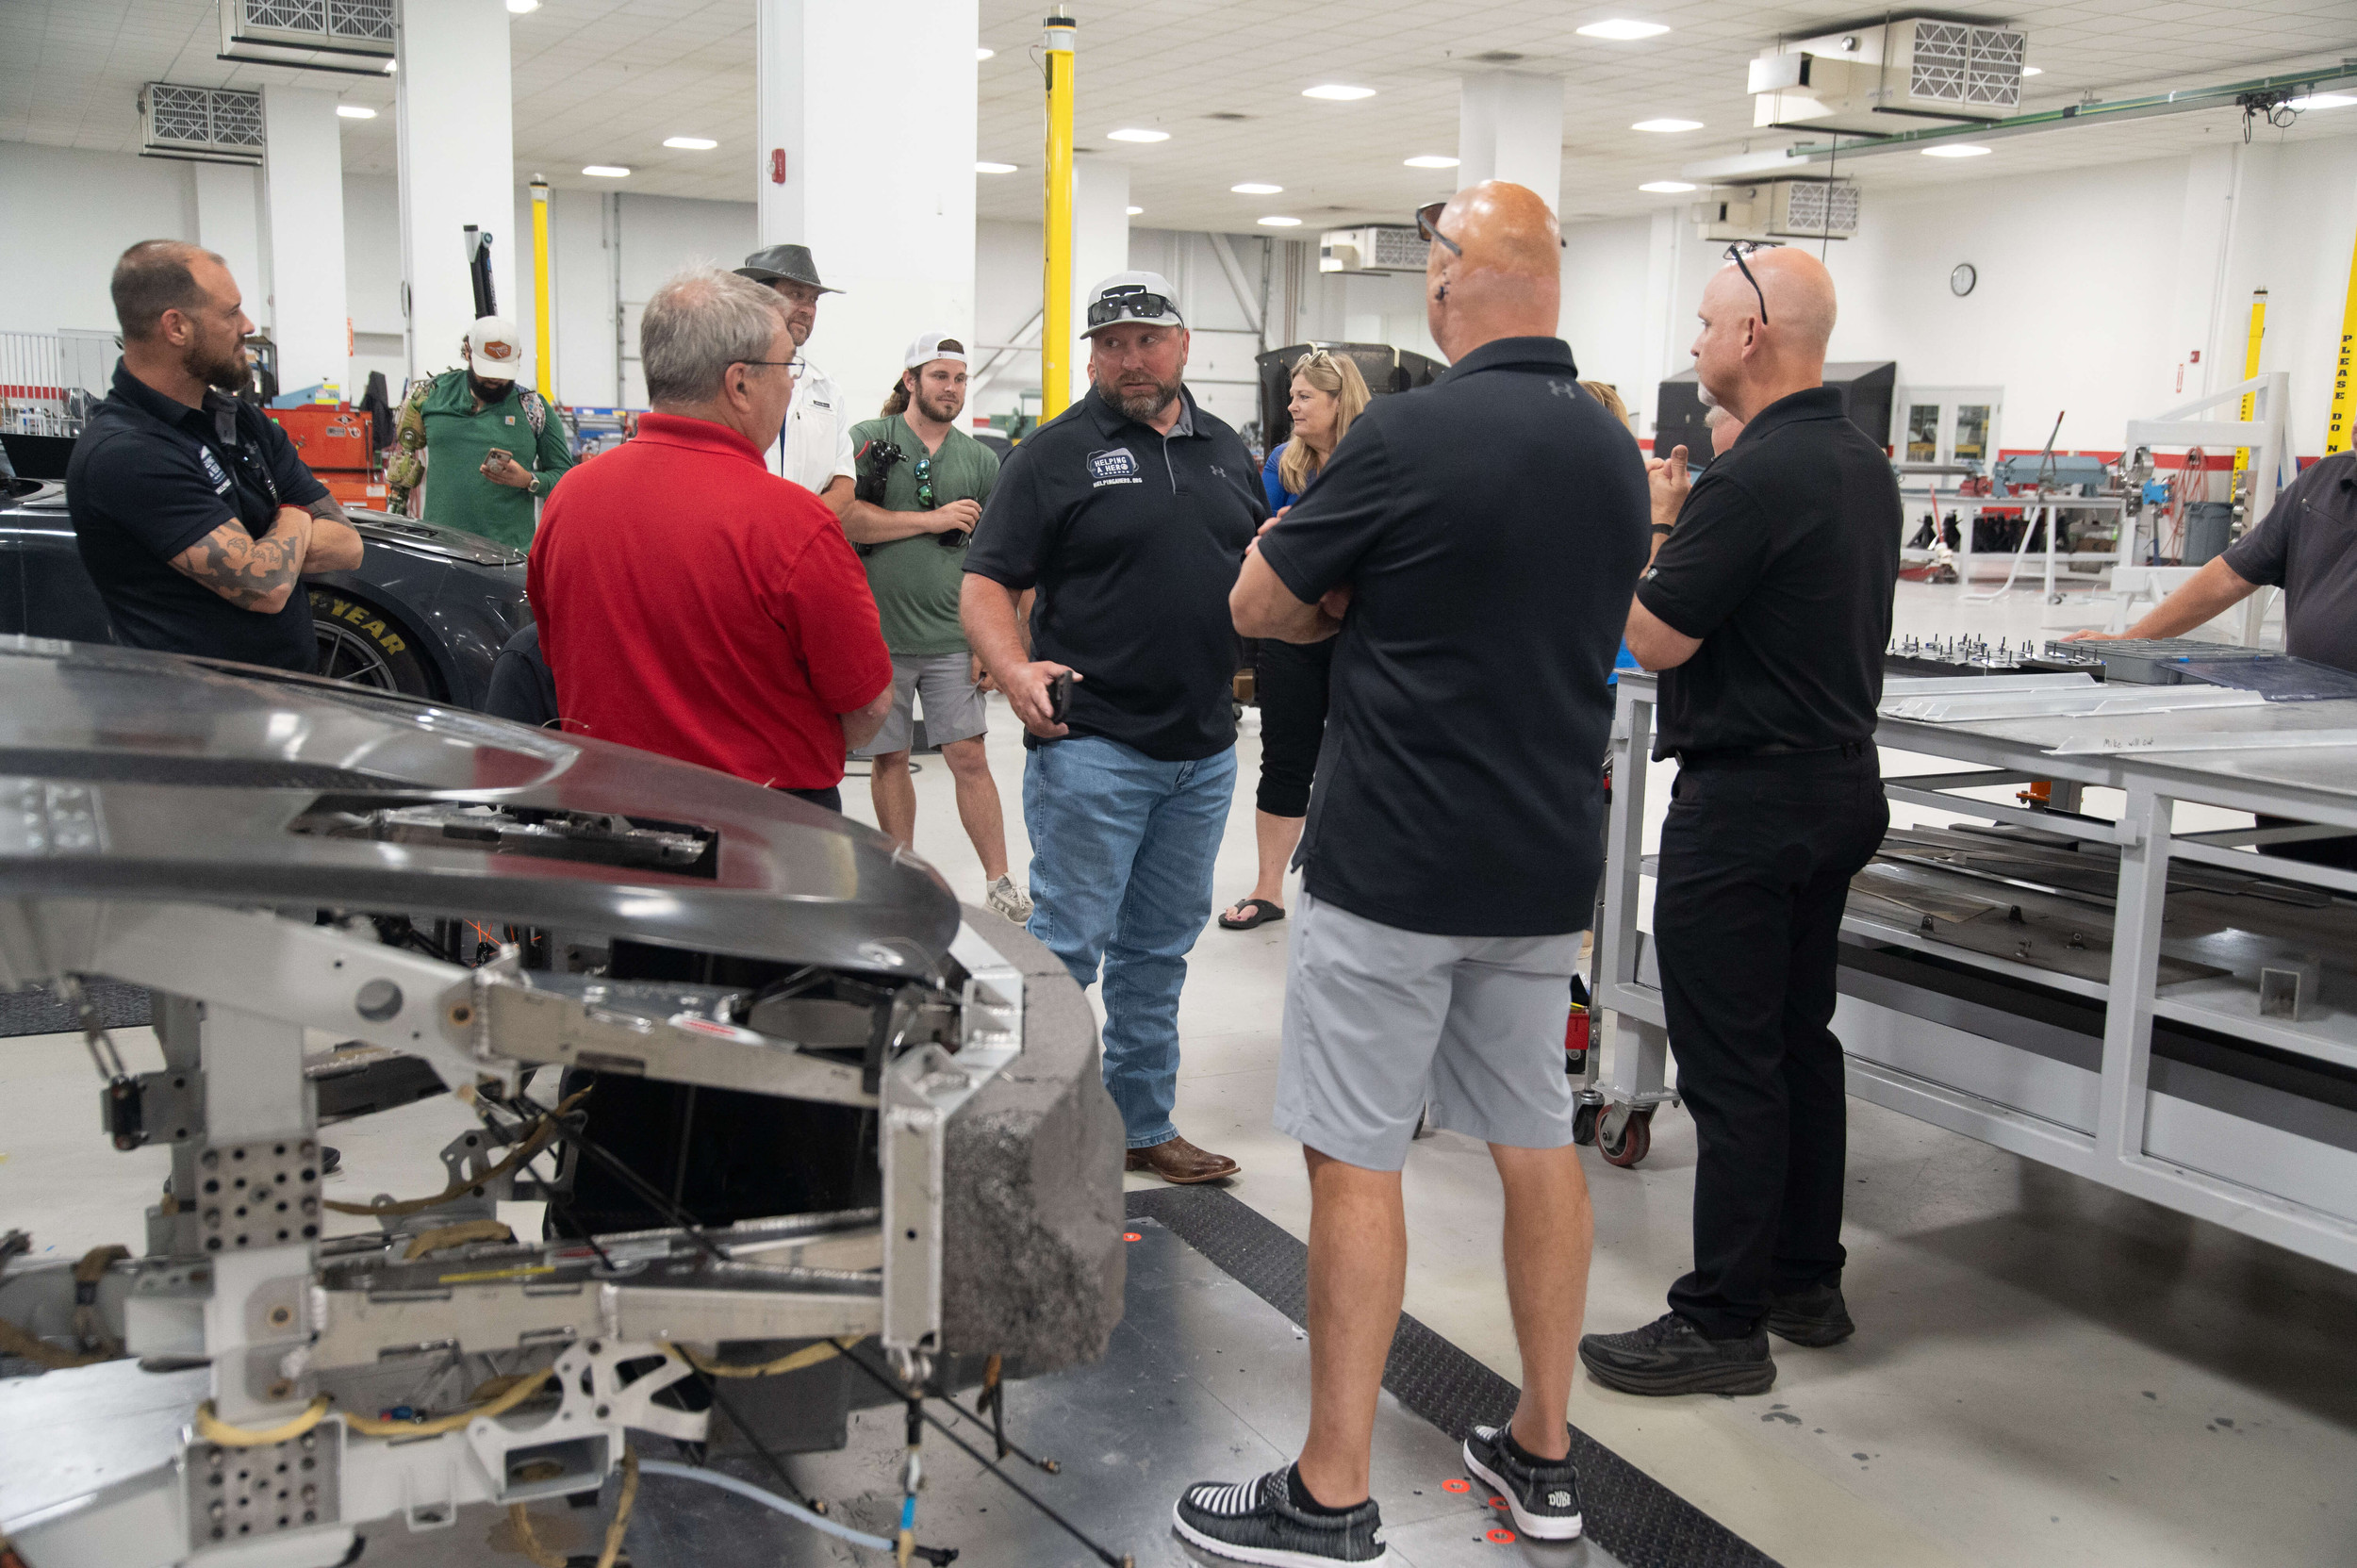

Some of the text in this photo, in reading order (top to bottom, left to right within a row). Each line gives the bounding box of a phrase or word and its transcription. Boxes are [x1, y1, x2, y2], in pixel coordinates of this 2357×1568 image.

[2334, 335, 2352, 400] PLEASE
[2330, 413, 2342, 432] DO
[1094, 456, 1127, 468] HELPING
[2103, 738, 2121, 749] Mike
